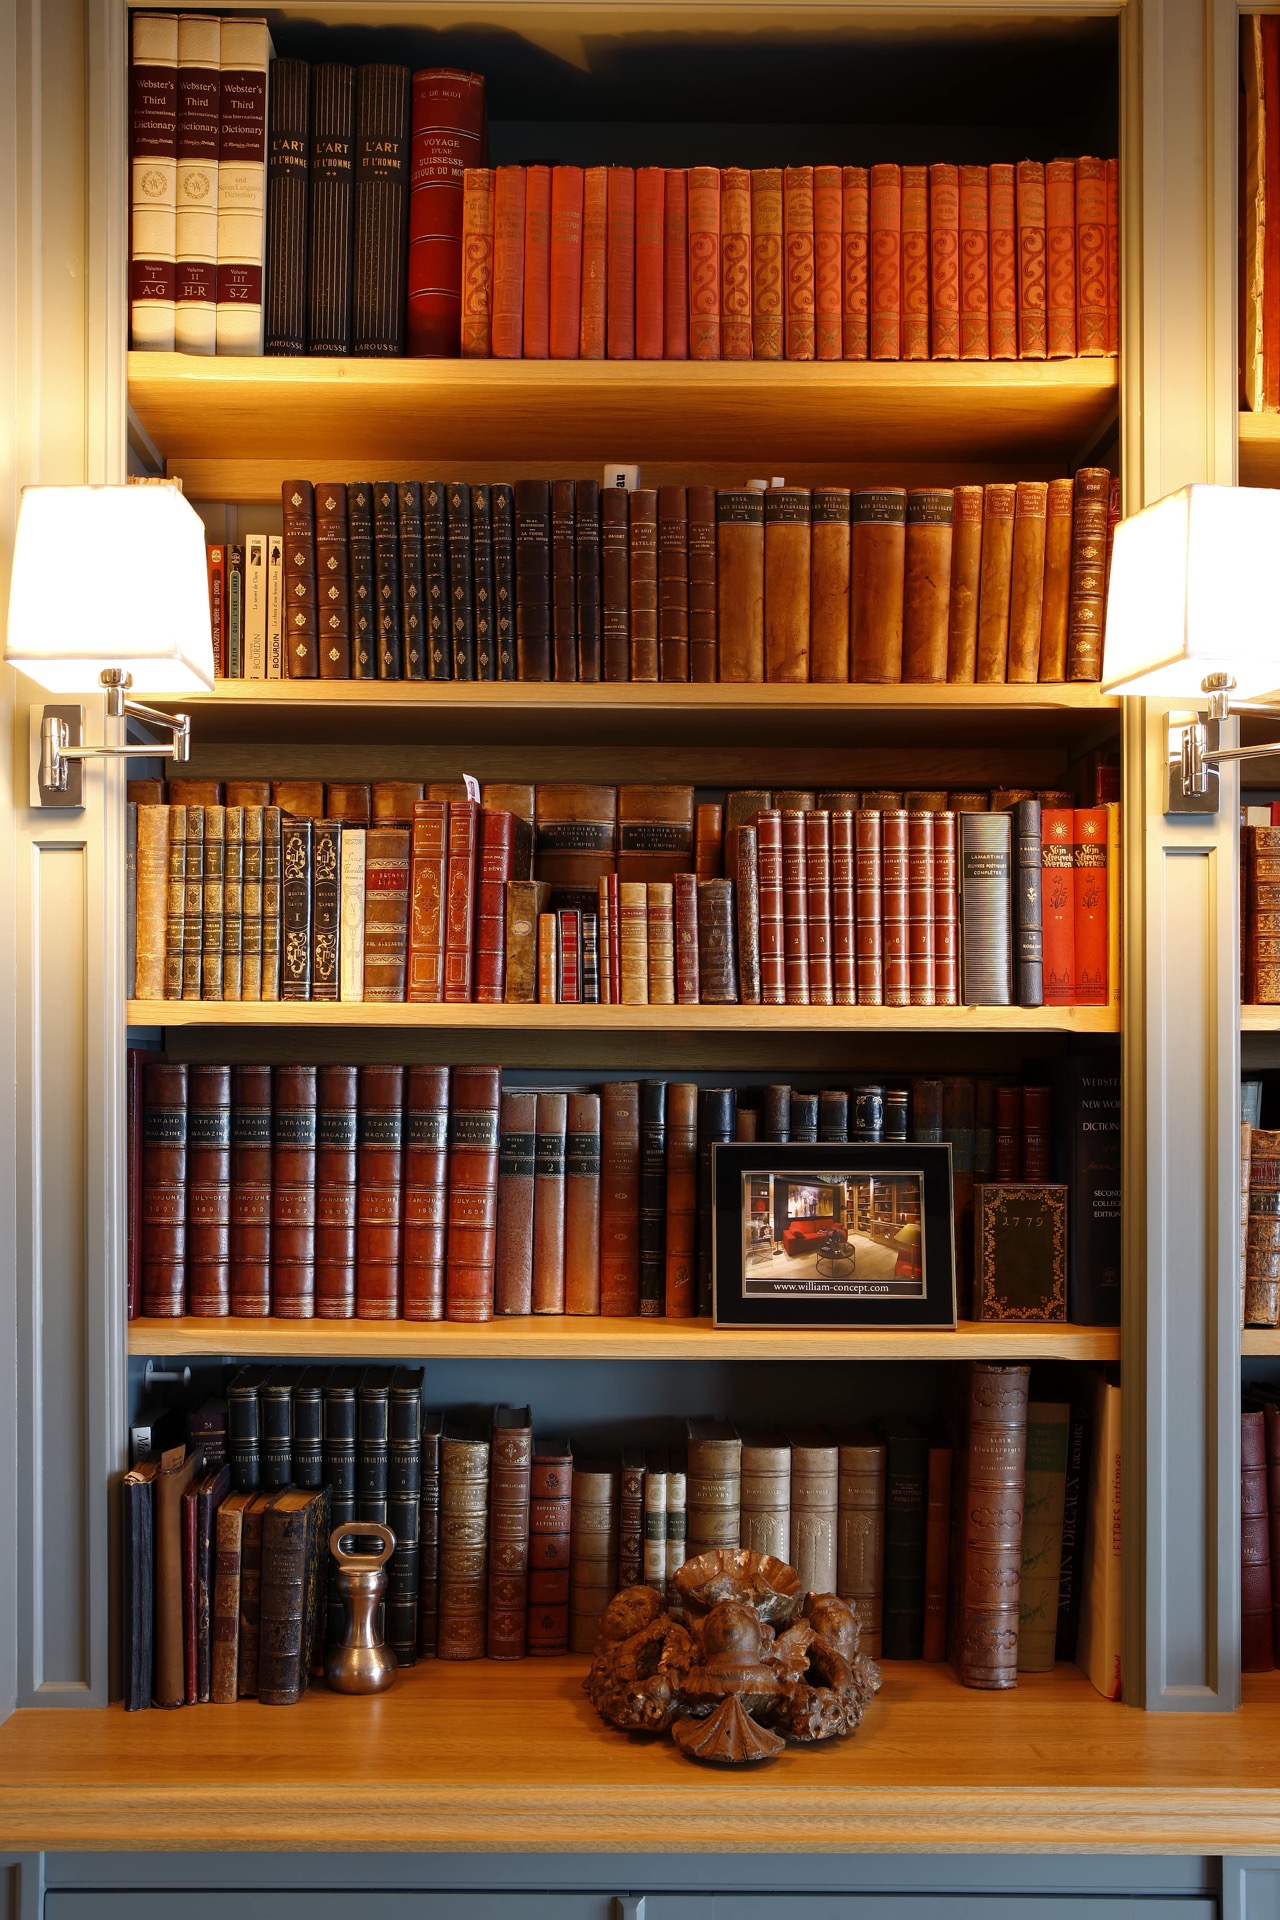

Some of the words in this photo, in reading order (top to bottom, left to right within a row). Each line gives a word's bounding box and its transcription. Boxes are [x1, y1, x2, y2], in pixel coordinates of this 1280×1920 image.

[137, 80, 174, 90] Webster's
[181, 81, 217, 92] Webster's
[224, 85, 262, 94] Webster's
[142, 95, 166, 105] Third
[186, 97, 209, 107] Third
[231, 100, 254, 109] Third
[134, 121, 176, 132] Dictionary
[178, 122, 219, 134] Dictionary
[222, 125, 263, 136] Dictionary
[273, 139, 305, 152] L'ART
[316, 142, 349, 154] L'ART
[365, 141, 399, 153] L'ART
[423, 139, 460, 148] VOYAGE
[270, 156, 277, 165] ET
[279, 155, 307, 169] L'HOMME
[322, 159, 352, 169] L'HOMME
[371, 157, 401, 170] L'HOMME
[419, 156, 464, 167] SUISSESSE
[411, 167, 435, 180] AUTOUR
[451, 167, 464, 177] MON
[224, 191, 257, 200] Dictionary
[233, 275, 245, 283] III
[142, 285, 166, 295] A-G
[184, 286, 206, 296] H-R
[229, 288, 248, 299] S-Z
[266, 340, 303, 351] LAROUSSE
[309, 343, 347, 353] LAROUSSE
[355, 343, 398, 352] LAROUSSE
[212, 580, 221, 594] poing
[253, 633, 261, 669] BOURDIN
[1049, 844, 1066, 856] Stijn
[1082, 844, 1099, 855] Stijn
[1042, 851, 1073, 862] Streuvels
[1043, 860, 1072, 868] Werken
[1077, 860, 1104, 868] Werken
[1081, 1100, 1100, 1108] NEW
[1082, 1122, 1120, 1131] DICTION
[547, 1163, 554, 1172] 2
[581, 1163, 587, 1171] 3
[1002, 1216, 1044, 1227] 1779
[773, 1282, 889, 1295] www.william-concept.com
[1071, 1423, 1083, 1469] raconte
[1112, 1453, 1122, 1504] intimes
[1063, 1477, 1080, 1546] DECAUX
[1058, 1555, 1073, 1611] ALAIN
